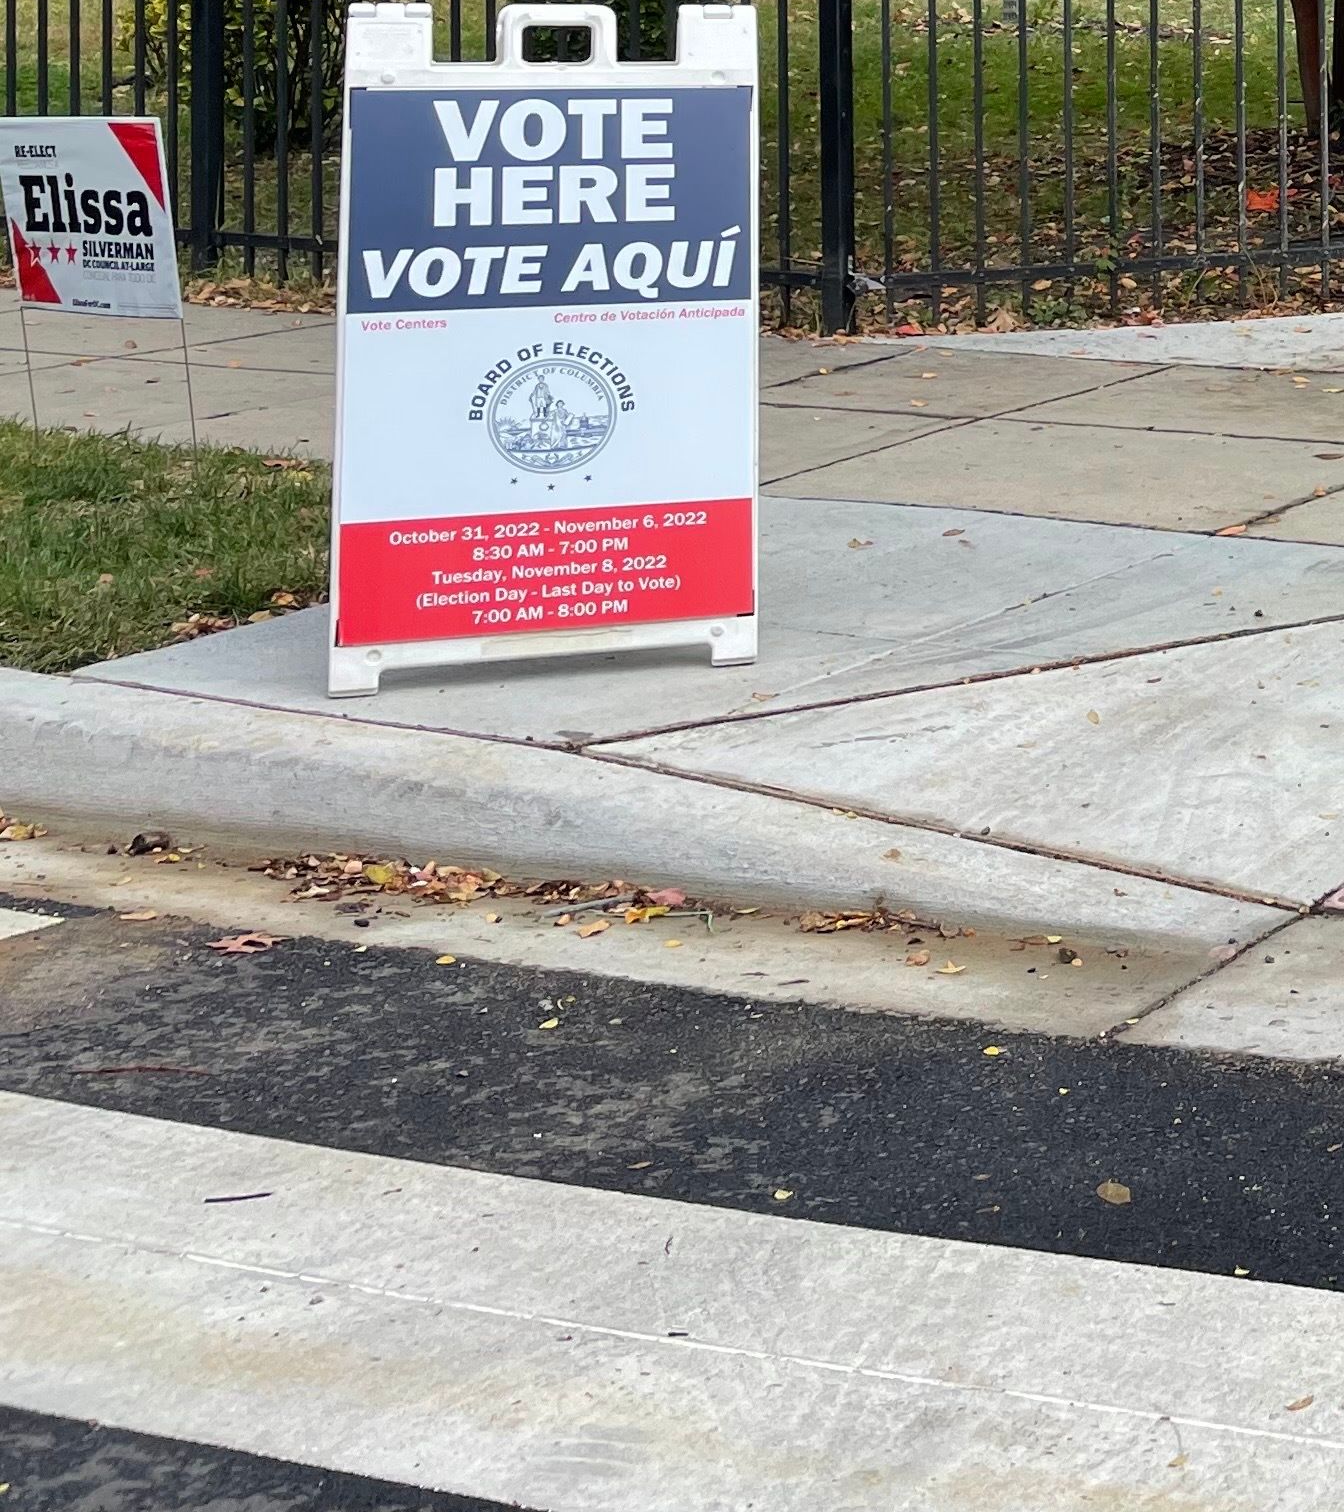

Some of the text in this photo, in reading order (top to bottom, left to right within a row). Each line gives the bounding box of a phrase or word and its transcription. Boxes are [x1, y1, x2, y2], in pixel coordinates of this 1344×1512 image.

[433, 98, 673, 162] VOTE
[15, 145, 56, 158] RE-ELECT
[19, 173, 152, 237] Elissa
[434, 163, 675, 227] HERE
[83, 240, 153, 260] SILVERMAN
[83, 259, 154, 271] DC COUNCIL AT-LARGE
[362, 225, 741, 299] VOTE AQUÍ
[361, 307, 745, 331] Vote Centers Centro de Votación Anticipada
[469, 342, 635, 420] BOARD OF ELECTIONS
[501, 369, 538, 405] DISTRICT
[560, 368, 603, 401] COLUMBIA
[390, 512, 707, 545] October 31, 2022 November 6, 2022
[473, 537, 629, 561] 8:30 AM 7:00 PM
[432, 556, 667, 586] Tuesday, November 8, 2022
[416, 575, 680, 610] (Election Day Last Day to Vote)
[473, 600, 628, 624] 7:00 AM 8:00 PM
